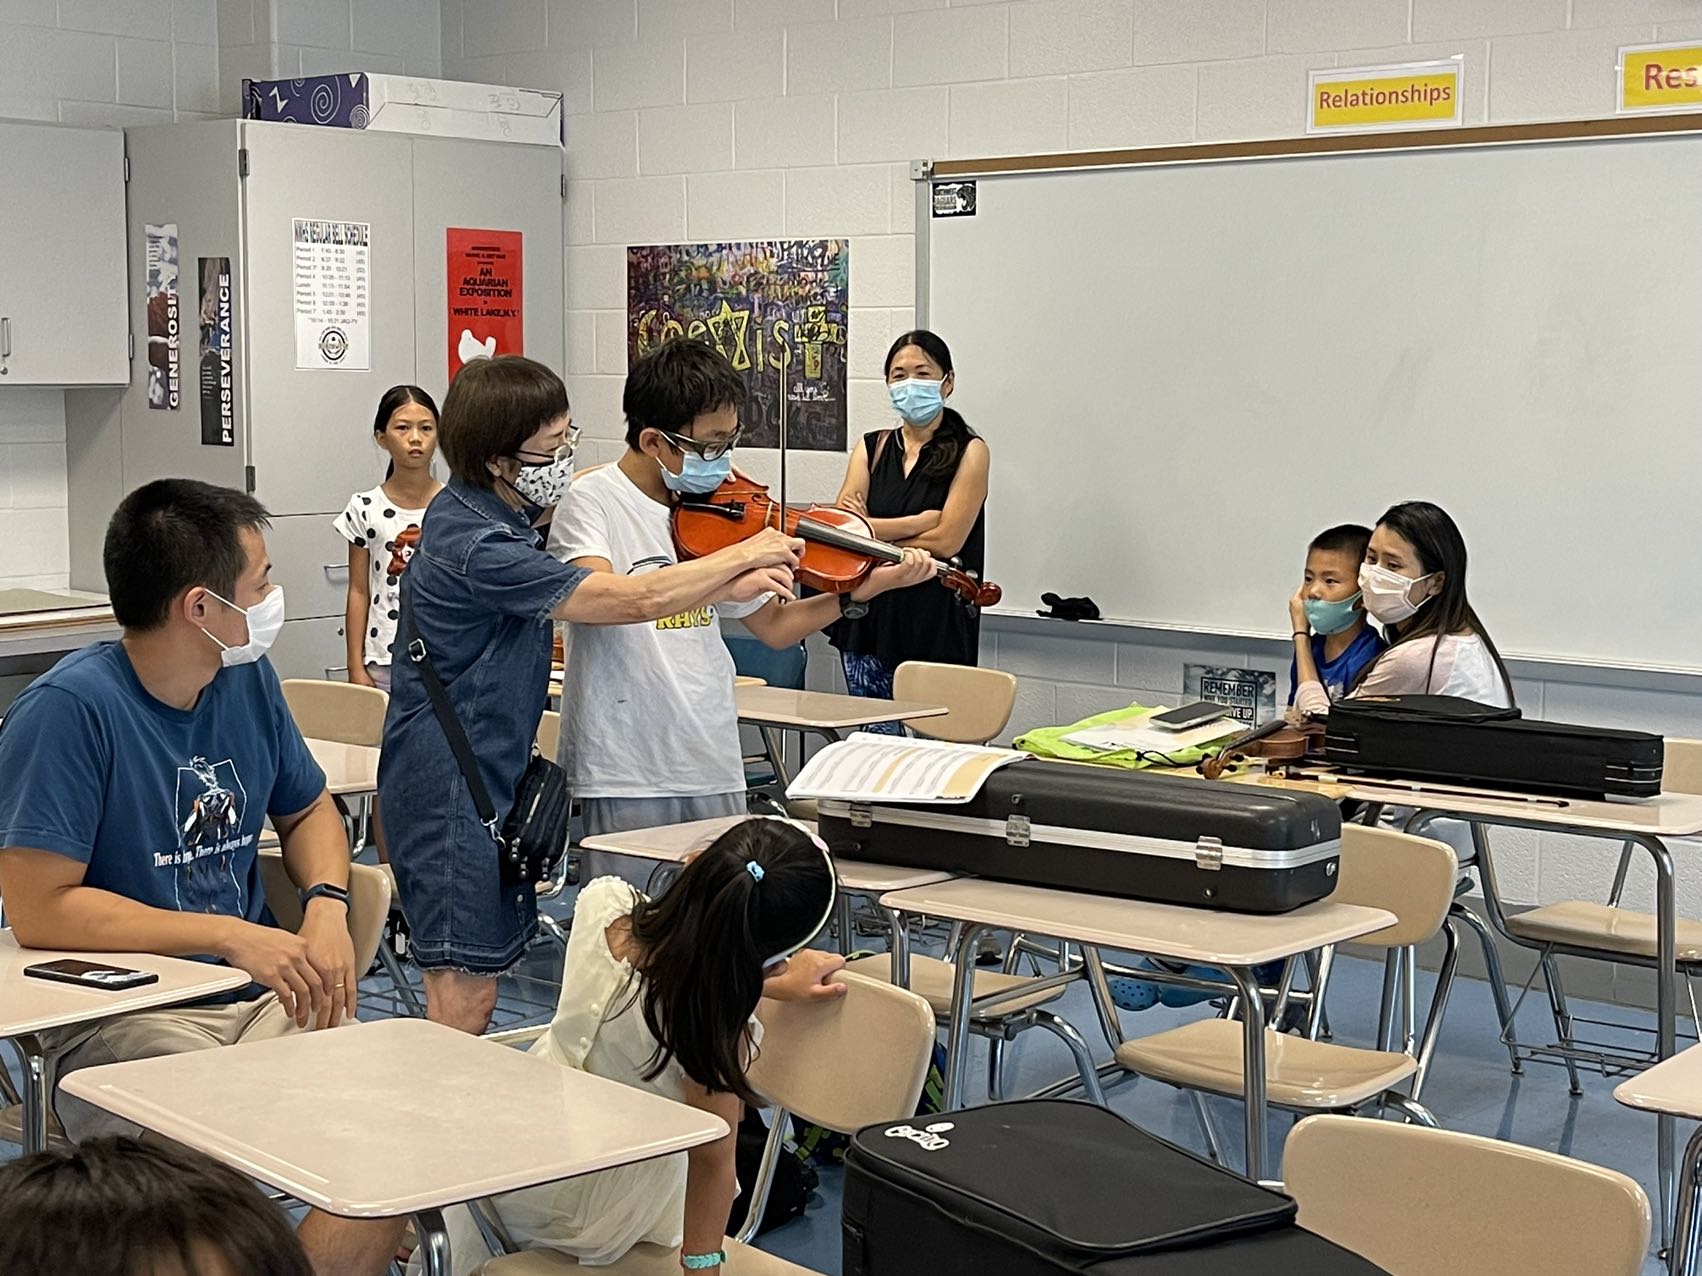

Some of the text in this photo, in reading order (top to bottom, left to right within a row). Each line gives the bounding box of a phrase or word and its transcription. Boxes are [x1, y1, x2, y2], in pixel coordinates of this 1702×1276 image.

[1644, 64, 1698, 90] Res
[1319, 83, 1451, 109] Relationships
[479, 268, 492, 276] AN
[463, 277, 508, 288] AQUARIAN
[460, 287, 512, 298] EXPOSITION
[453, 308, 479, 316] WHITE
[219, 273, 233, 443] PERSEVERANCE
[1204, 681, 1254, 698] REMEMBER
[1242, 708, 1253, 719] UP.
[154, 852, 172, 867] There
[174, 850, 182, 864] is
[195, 845, 214, 858] There
[214, 842, 221, 854] is
